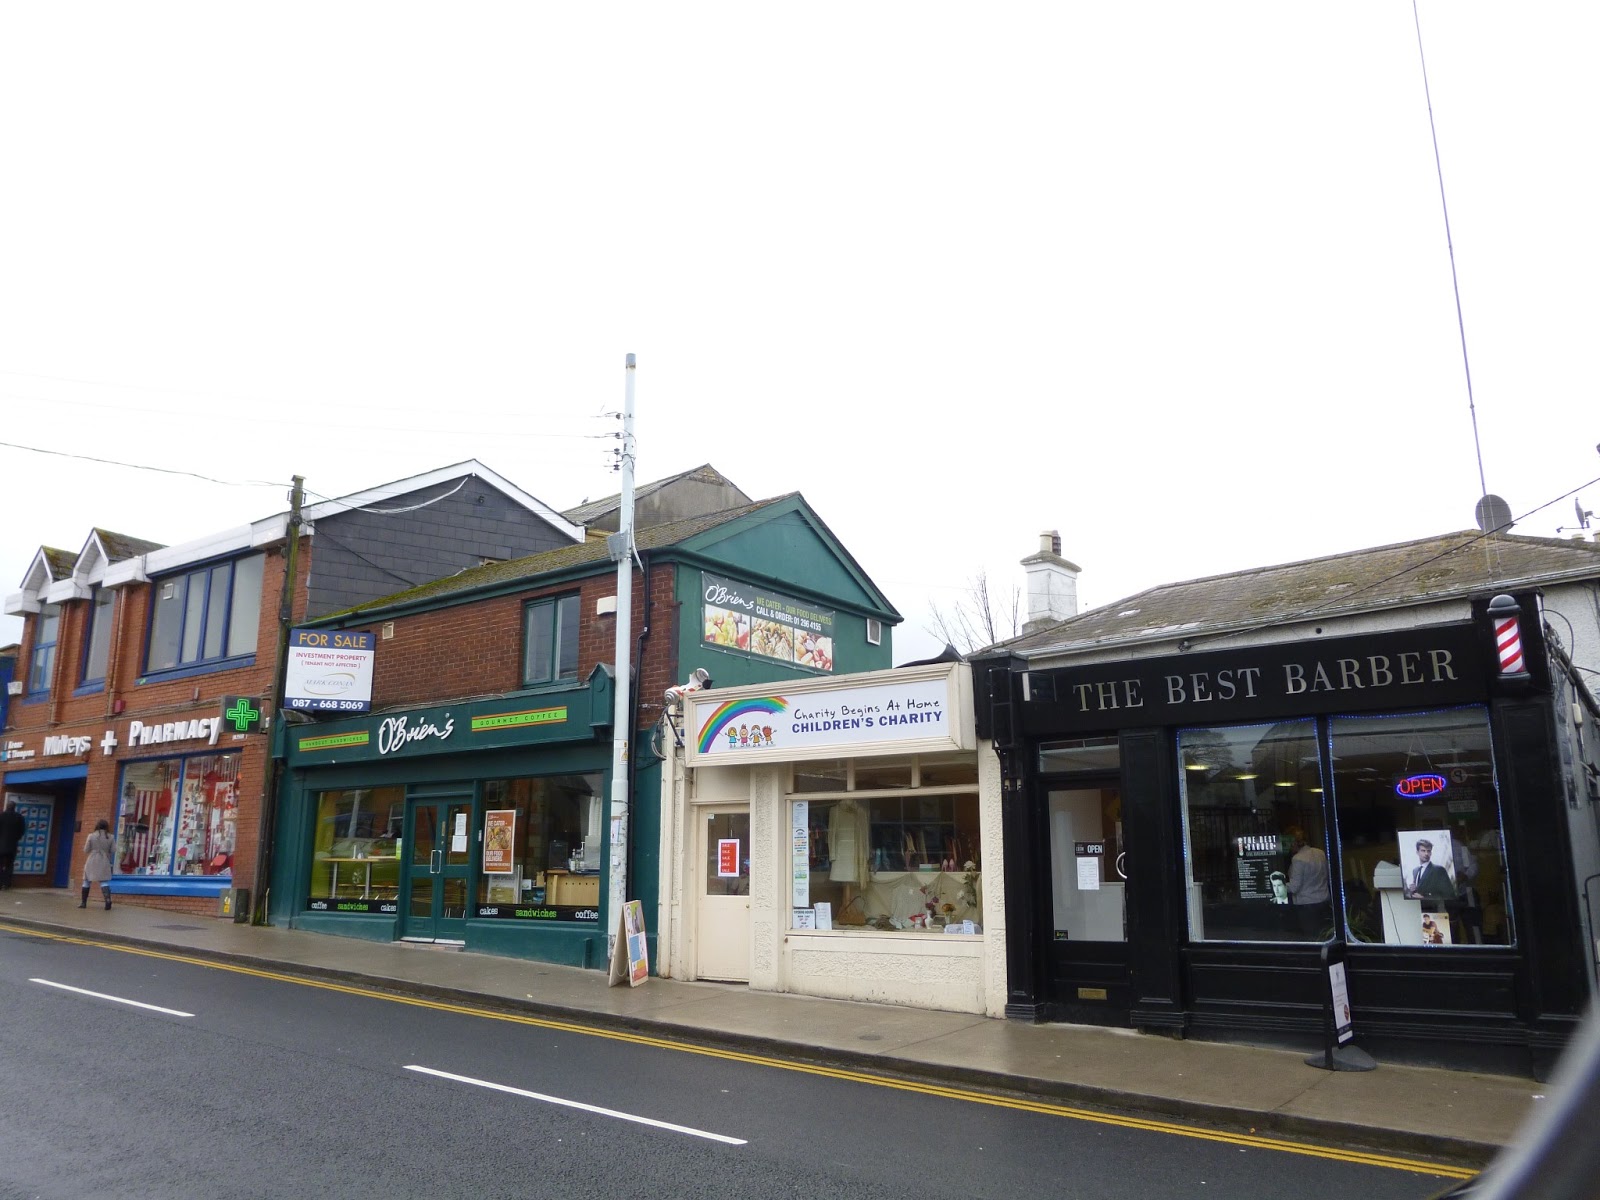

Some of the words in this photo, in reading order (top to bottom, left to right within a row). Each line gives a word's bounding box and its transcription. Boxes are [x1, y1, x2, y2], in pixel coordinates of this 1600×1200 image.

[705, 584, 754, 609] O'Briens
[756, 596, 765, 606] WE
[765, 598, 782, 611] CATER
[786, 605, 796, 614] OUR
[797, 608, 810, 619] FOOD
[810, 612, 832, 625] DELIVERS
[756, 605, 769, 617] CALL
[770, 609, 775, 618] &
[775, 612, 794, 623] ORDER:
[794, 616, 800, 625] 01
[801, 618, 810, 628] 296
[810, 621, 822, 631] 4155
[299, 633, 329, 646] FOR
[334, 635, 367, 648] SALE
[296, 652, 335, 660] INVESTMENT
[1073, 679, 1144, 712] THE
[1164, 667, 1260, 705] BEST
[1282, 649, 1458, 694] BARBER
[292, 699, 312, 707] 087
[320, 700, 337, 709] 668
[340, 701, 363, 710] 5069
[794, 708, 835, 720] Charity
[841, 705, 880, 717] Begins
[886, 699, 900, 711] At
[907, 698, 940, 710] Home
[480, 716, 519, 726] GOURMET
[524, 712, 558, 721] COFFEE
[792, 717, 874, 733] CHILDREN'S
[879, 711, 942, 726] CHARITY
[1399, 776, 1443, 794] OPEN
[1243, 836, 1256, 844] THE
[1259, 835, 1276, 844] BEST
[1087, 844, 1103, 853] OPEN
[311, 901, 328, 910] coffee
[337, 902, 369, 911] sandwiches
[380, 903, 397, 912] cakes
[479, 906, 499, 915] cakes
[515, 908, 557, 918] sandwiches
[575, 909, 599, 919] coffee
